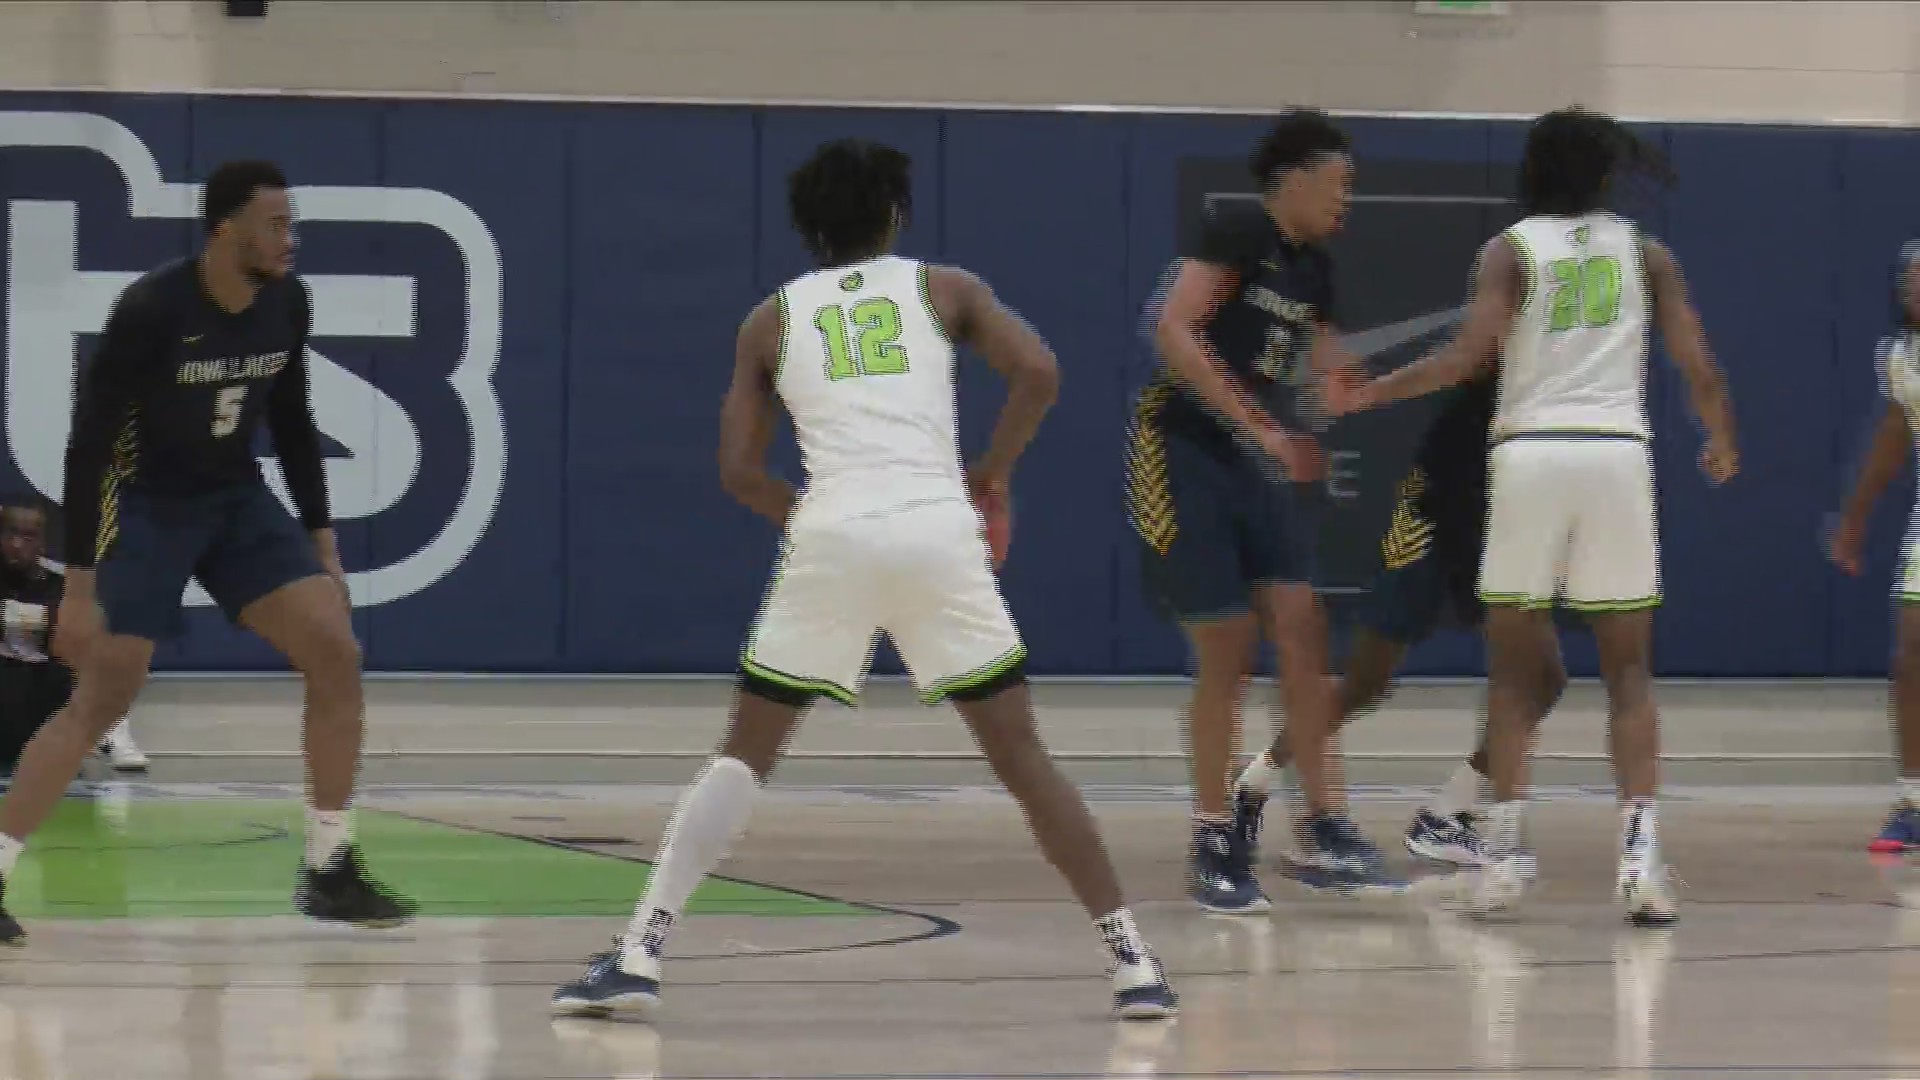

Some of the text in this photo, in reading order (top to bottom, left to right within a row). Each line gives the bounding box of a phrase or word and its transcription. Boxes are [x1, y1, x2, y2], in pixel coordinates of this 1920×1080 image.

[1546, 257, 1623, 333] 20
[814, 298, 910, 382] 12
[210, 385, 248, 440] 5
